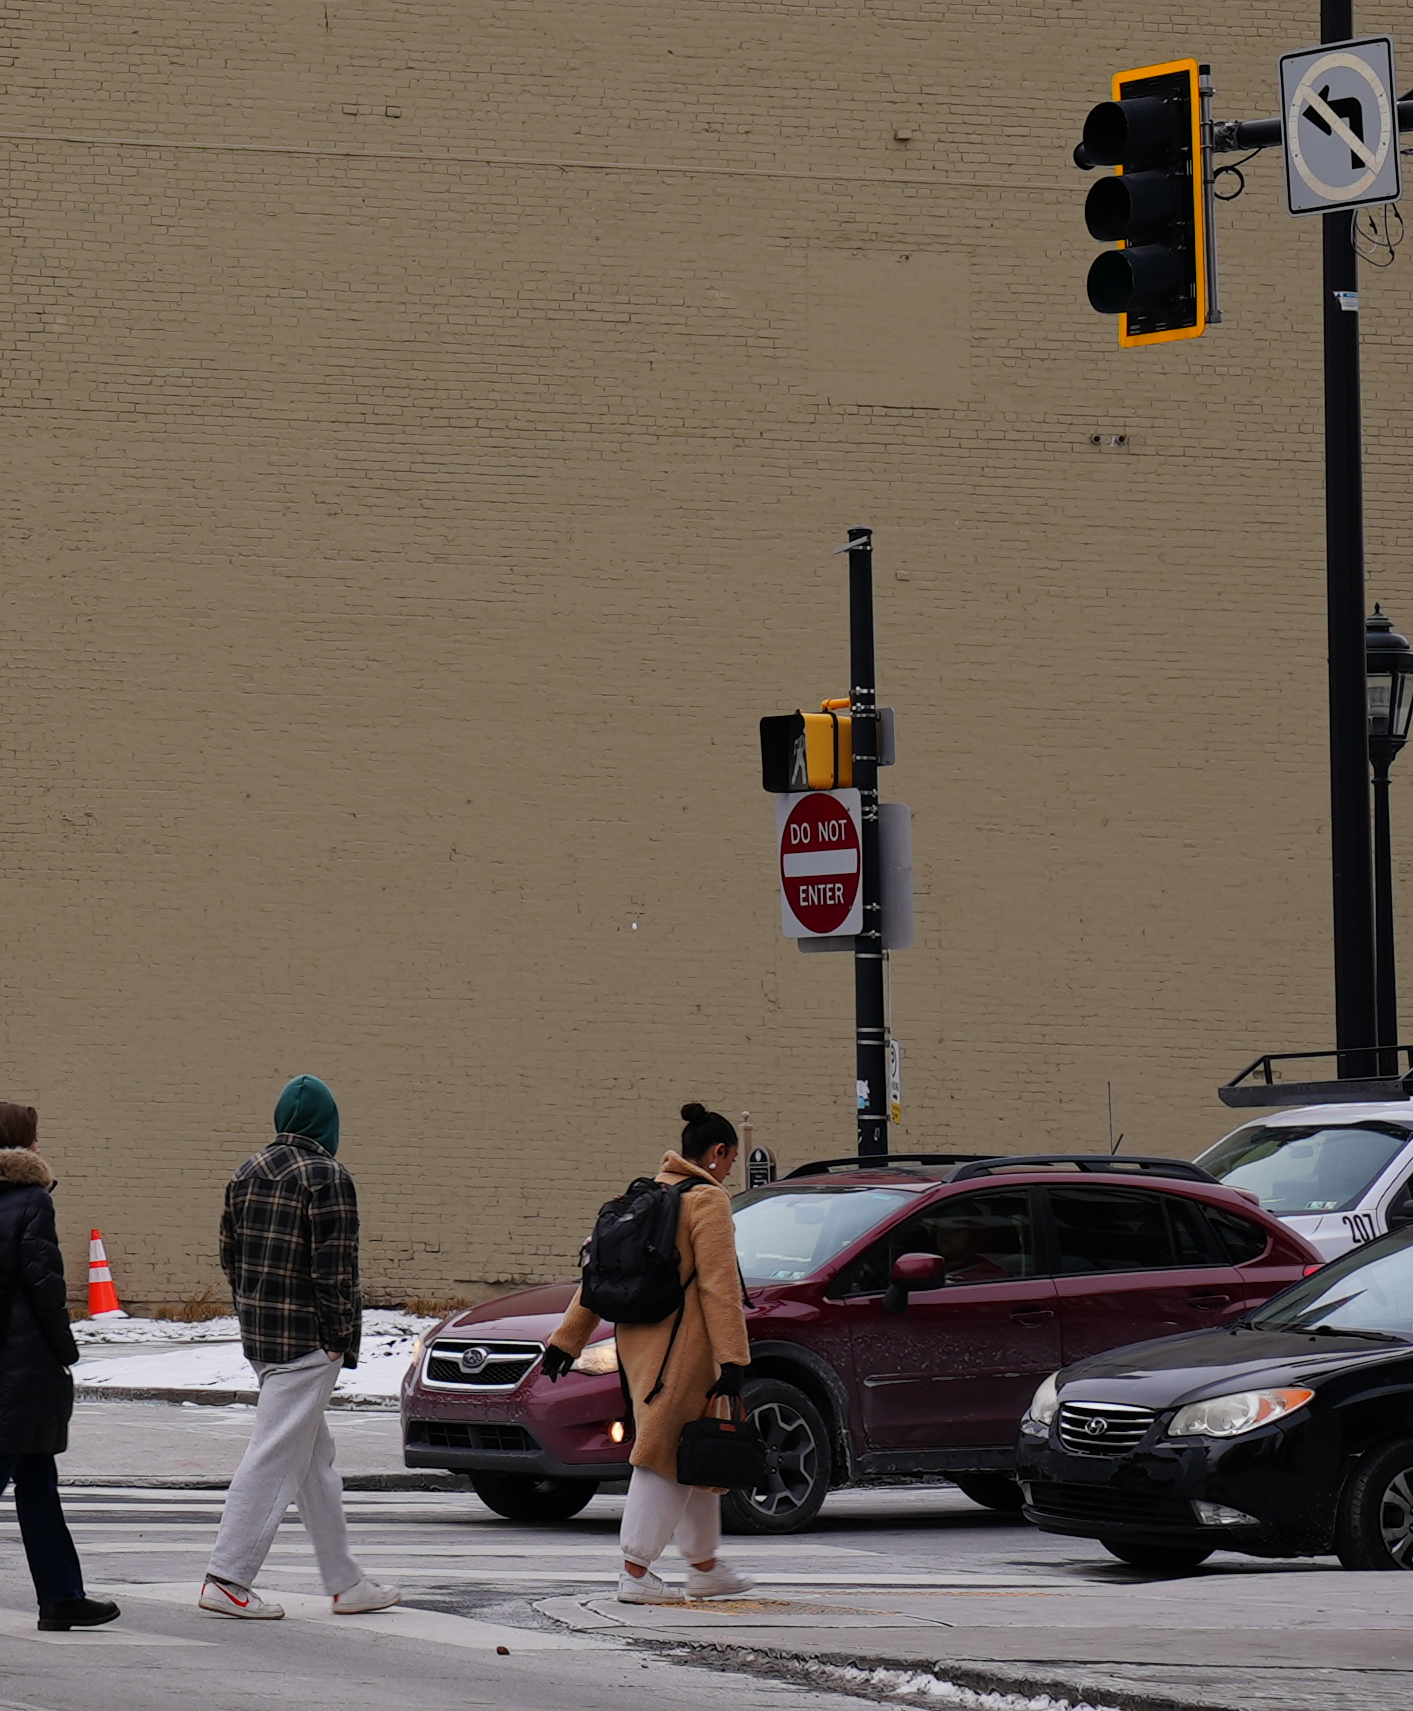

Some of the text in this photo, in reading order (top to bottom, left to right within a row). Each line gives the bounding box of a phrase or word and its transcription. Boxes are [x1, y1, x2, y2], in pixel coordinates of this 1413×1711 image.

[789, 819, 848, 845] DO NOT
[799, 883, 845, 906] ENTER
[1341, 1213, 1377, 1244] 207
